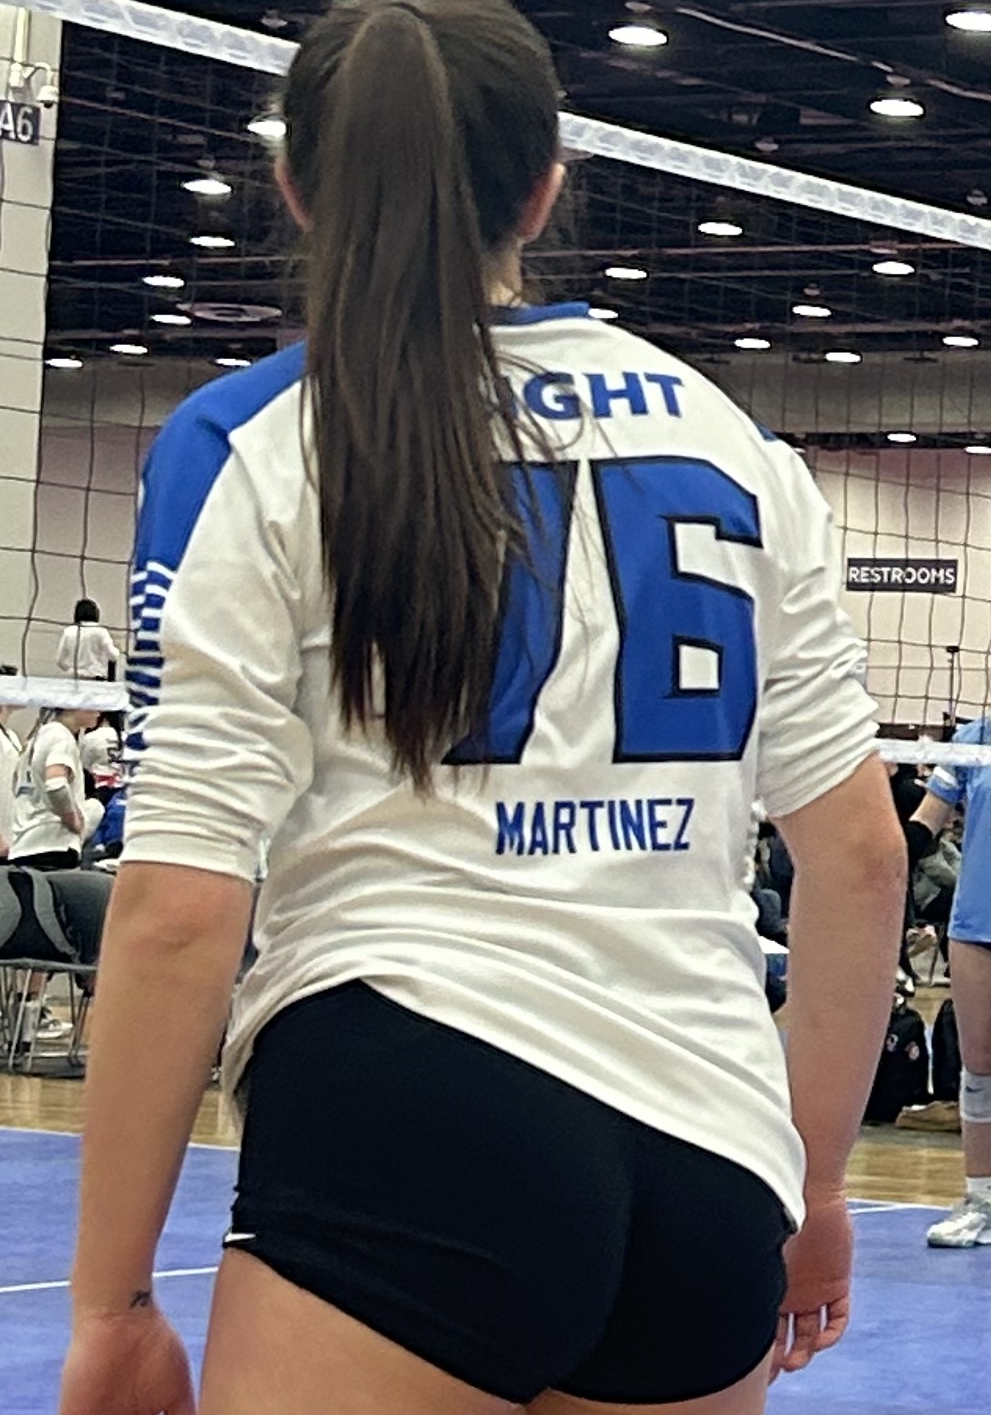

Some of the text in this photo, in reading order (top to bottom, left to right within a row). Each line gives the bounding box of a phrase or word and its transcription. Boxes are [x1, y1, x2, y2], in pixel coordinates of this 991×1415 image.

[0, 102, 34, 142] A6
[848, 566, 955, 585] RESTROOMS
[495, 797, 695, 856] MARTINEZ
